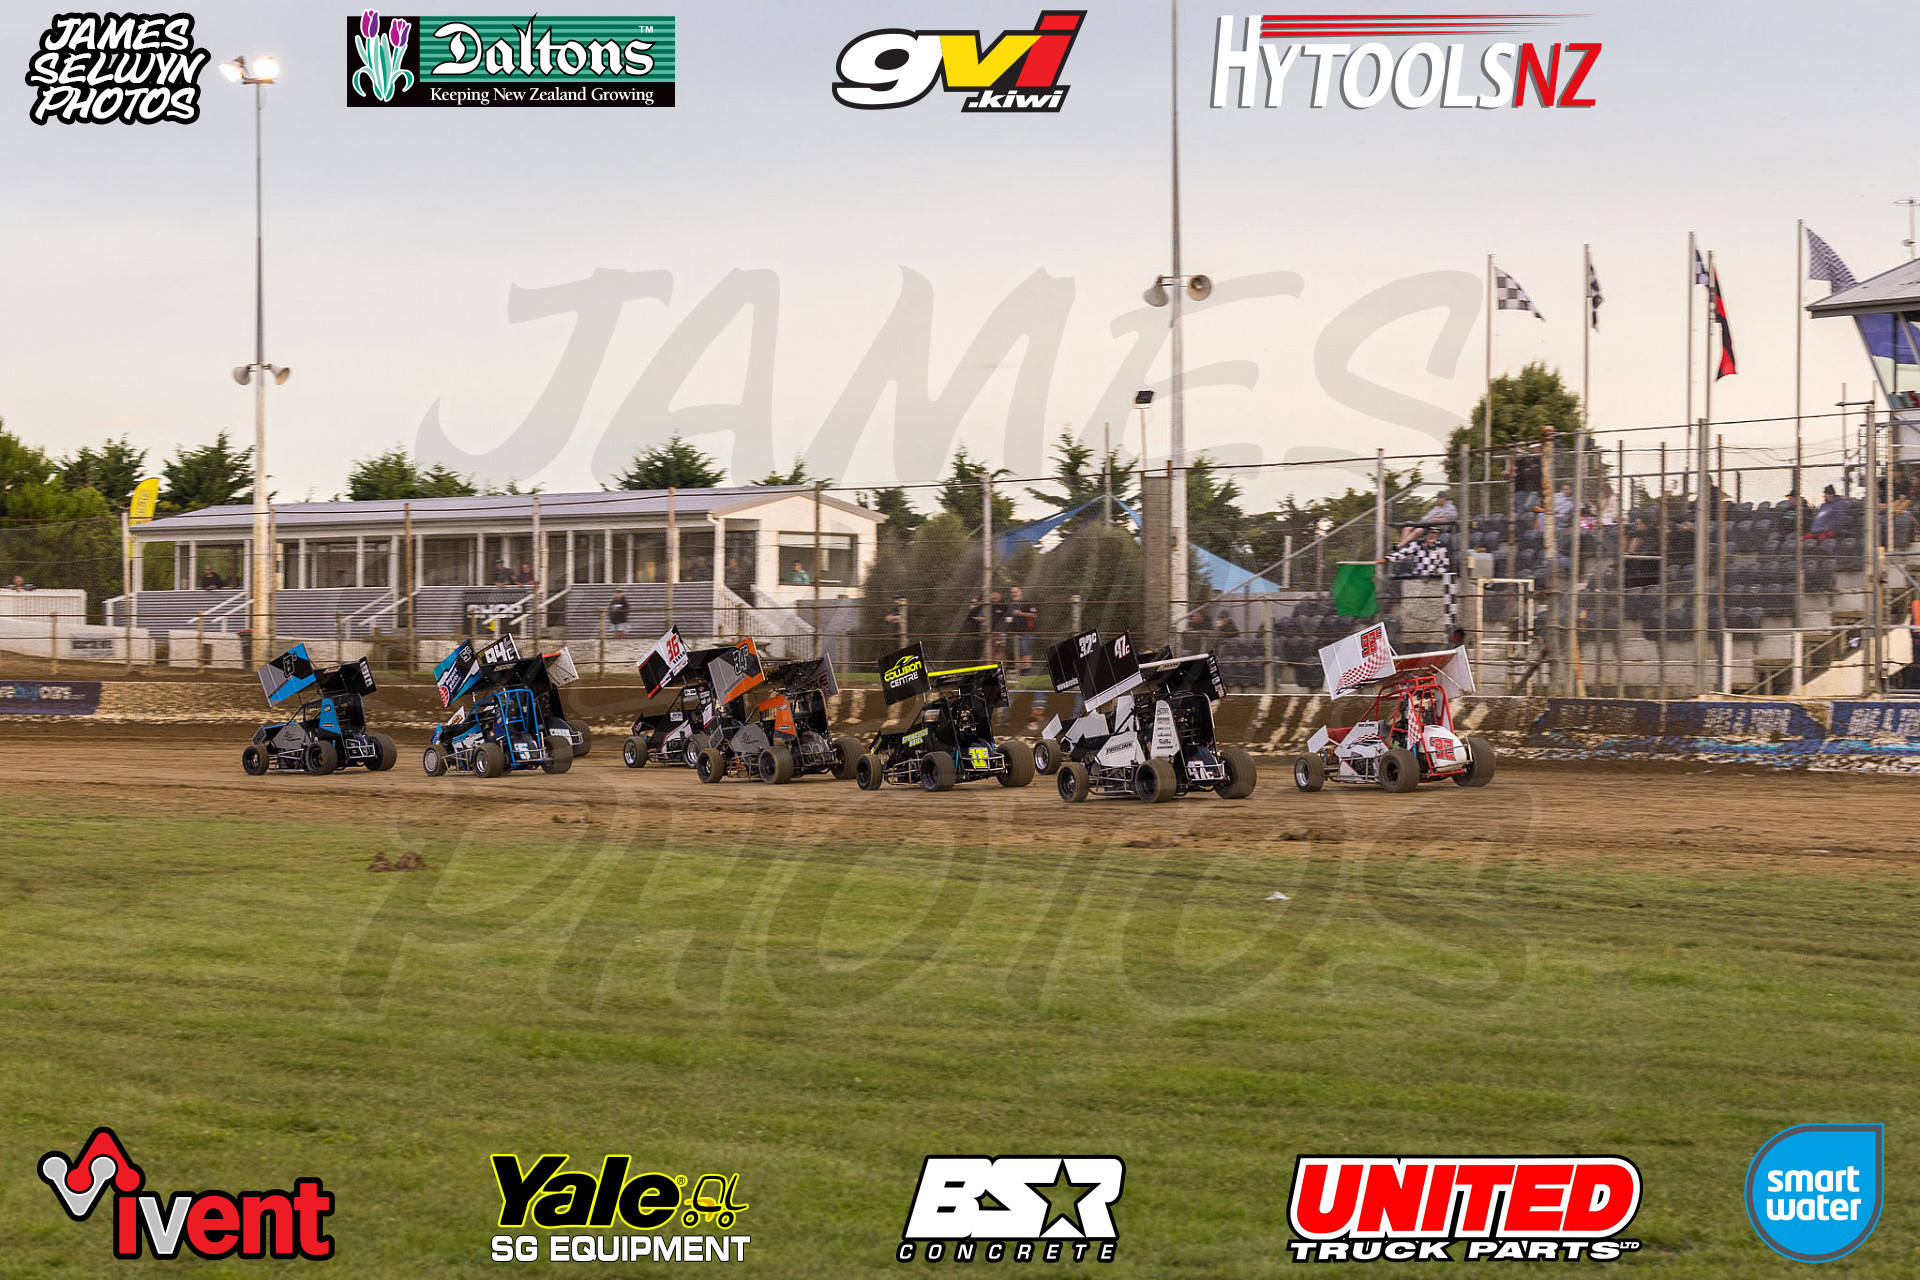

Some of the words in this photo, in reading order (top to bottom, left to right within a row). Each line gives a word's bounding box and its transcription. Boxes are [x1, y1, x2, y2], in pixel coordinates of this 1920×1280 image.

[666, 635, 680, 662] 36
[884, 660, 922, 682] COLLISION
[890, 671, 919, 688] CENTRE
